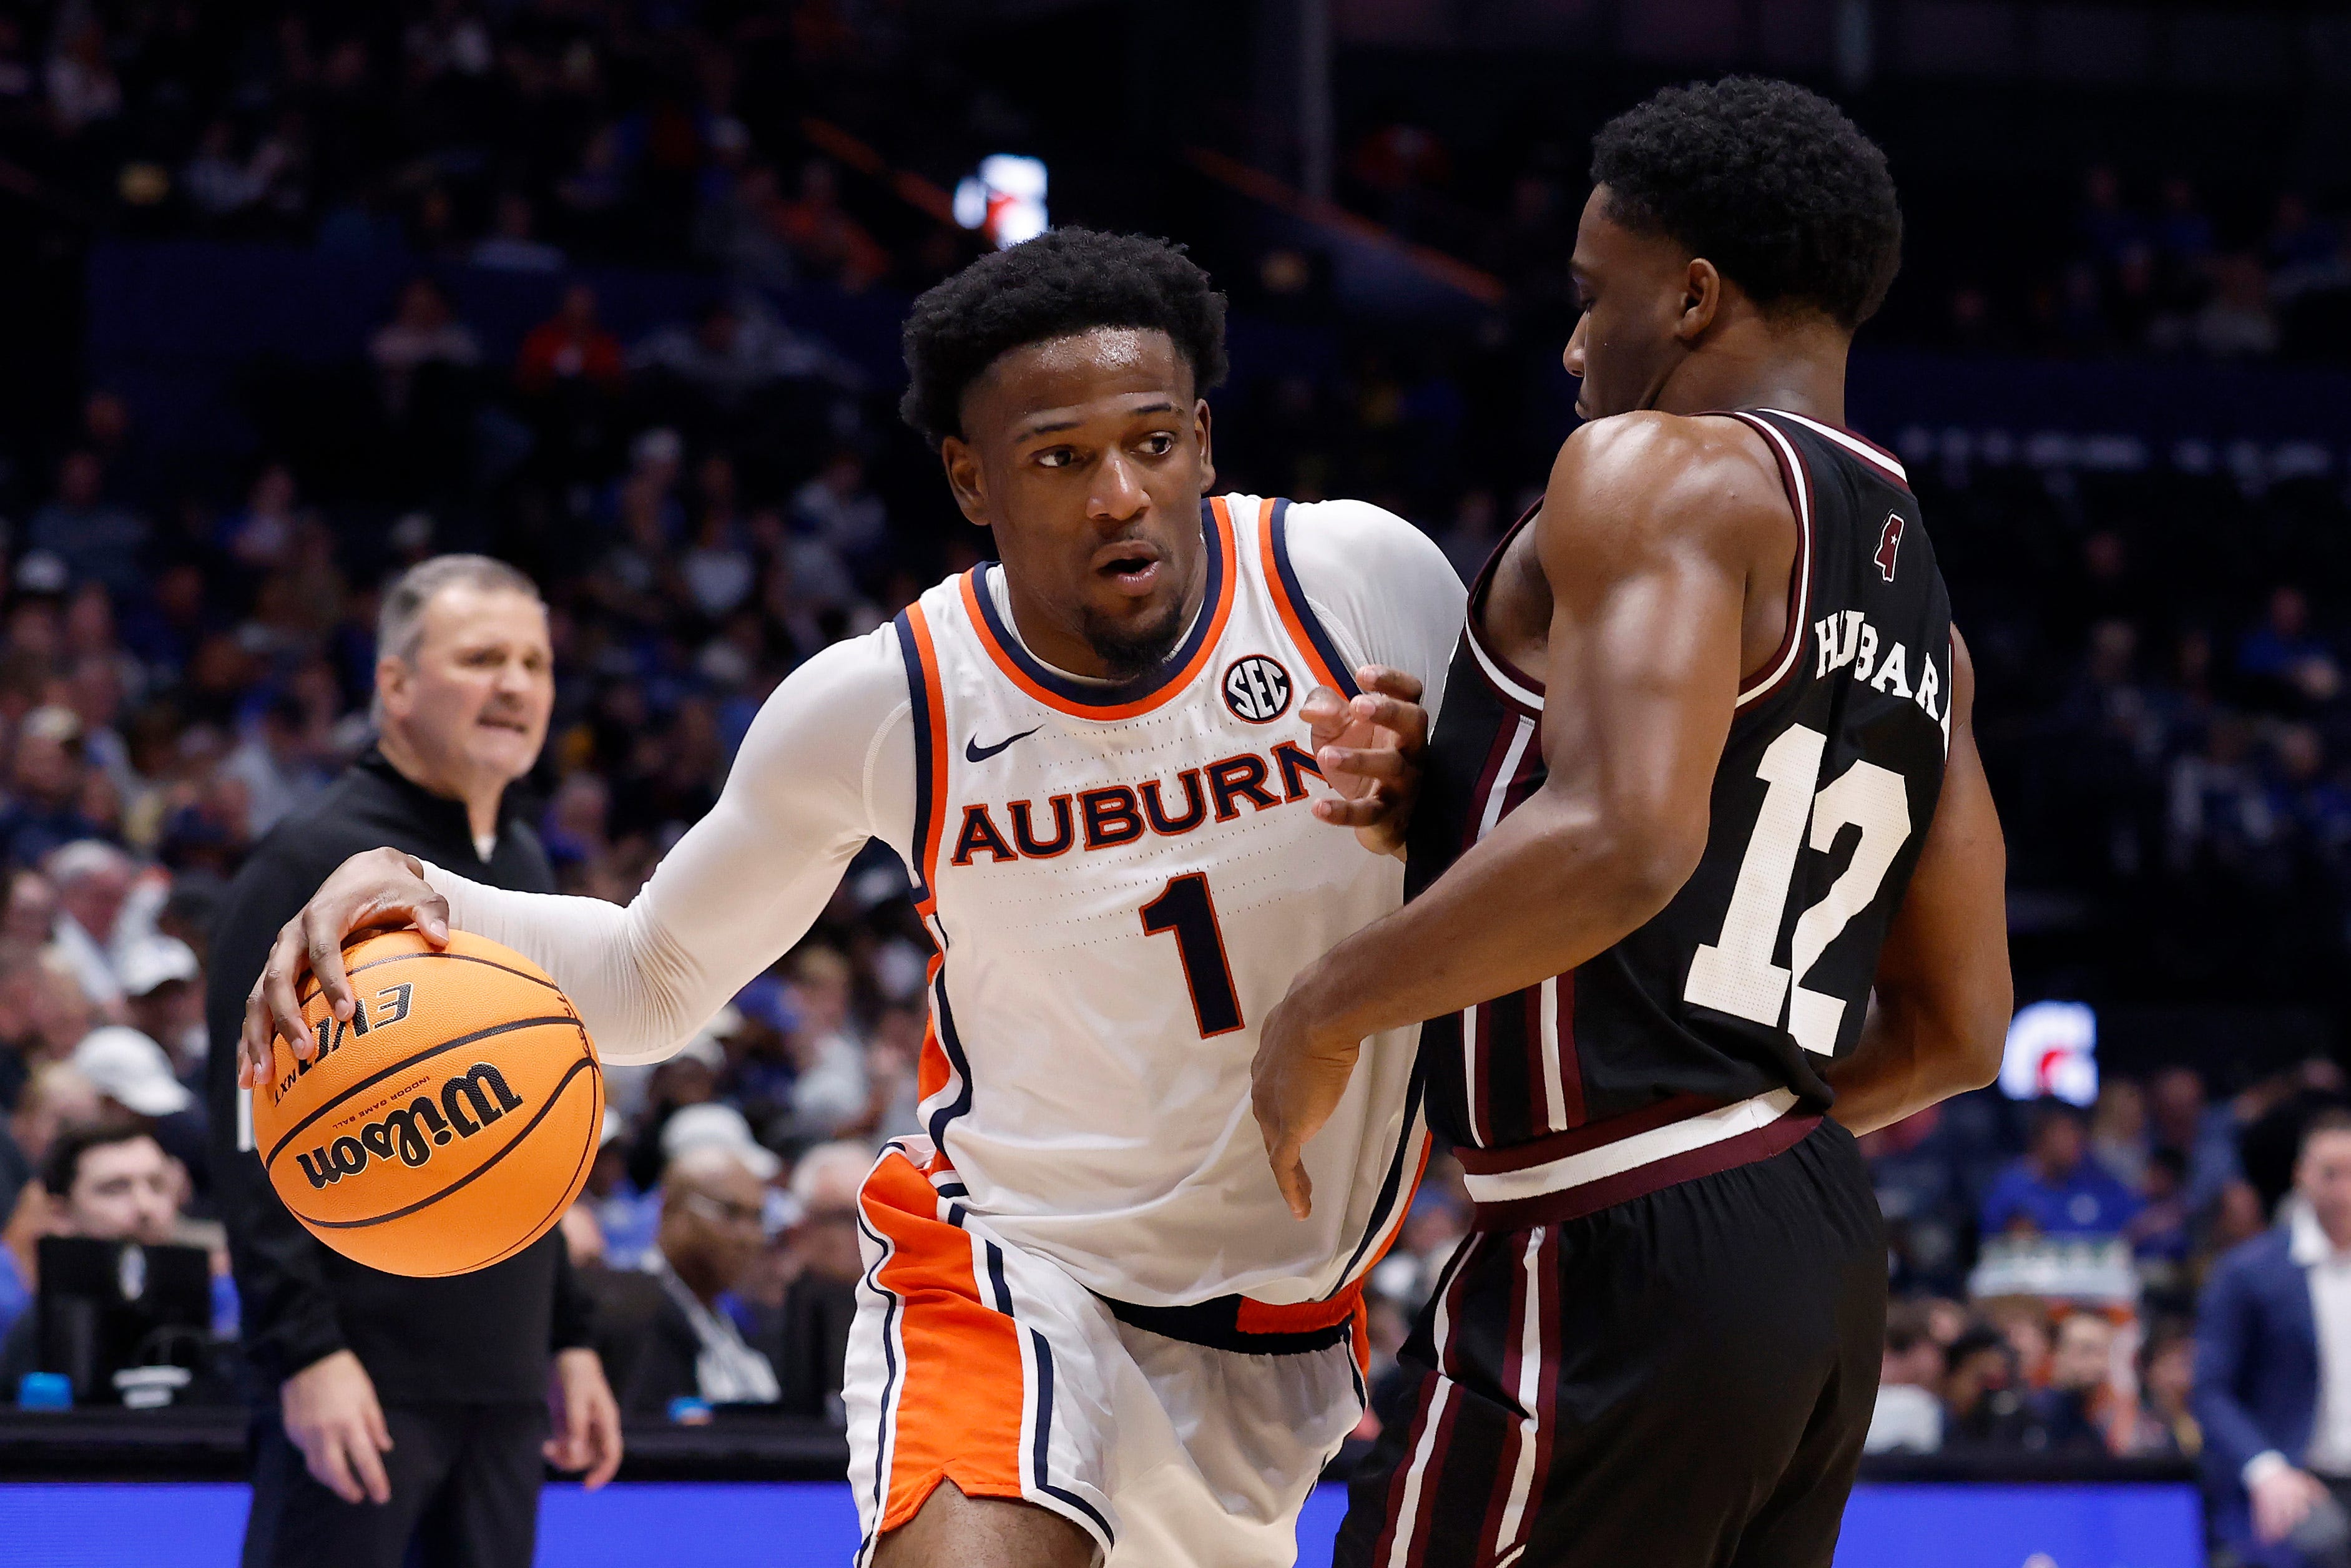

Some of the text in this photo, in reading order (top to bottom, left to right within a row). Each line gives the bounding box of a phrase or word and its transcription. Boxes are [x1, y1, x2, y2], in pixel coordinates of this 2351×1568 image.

[1227, 659, 1288, 720] SEC
[1683, 722, 1911, 1057] 12
[1139, 871, 1245, 1039] 1
[275, 1068, 297, 1107] NXT
[295, 1061, 524, 1189] Wilson
[332, 1076, 430, 1129] INDOOR GAME BALL
